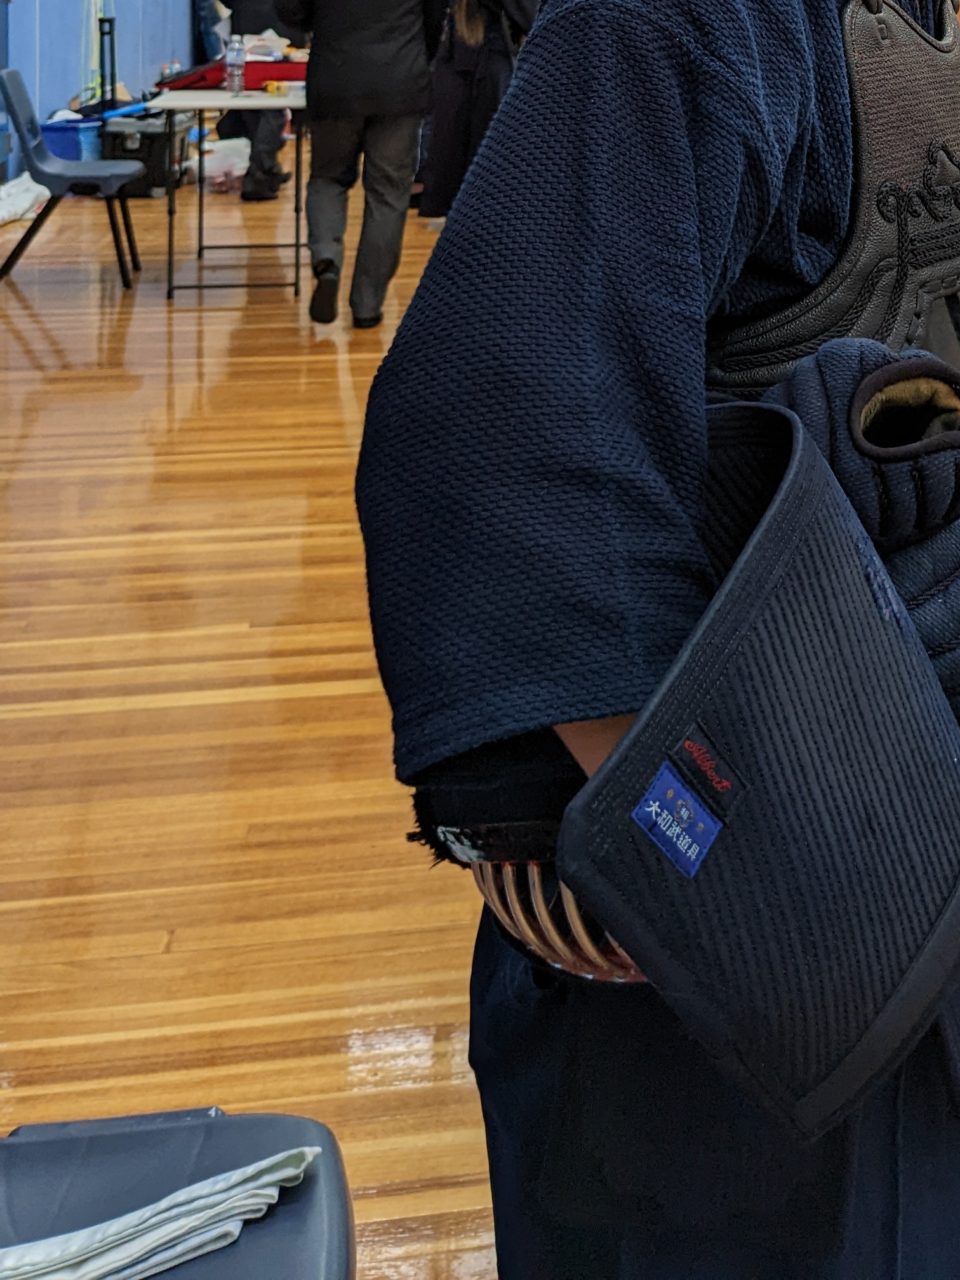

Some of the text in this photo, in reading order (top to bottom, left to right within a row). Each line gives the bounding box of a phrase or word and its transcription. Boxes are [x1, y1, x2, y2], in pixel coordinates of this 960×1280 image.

[643, 799, 701, 862] 大和武道具
